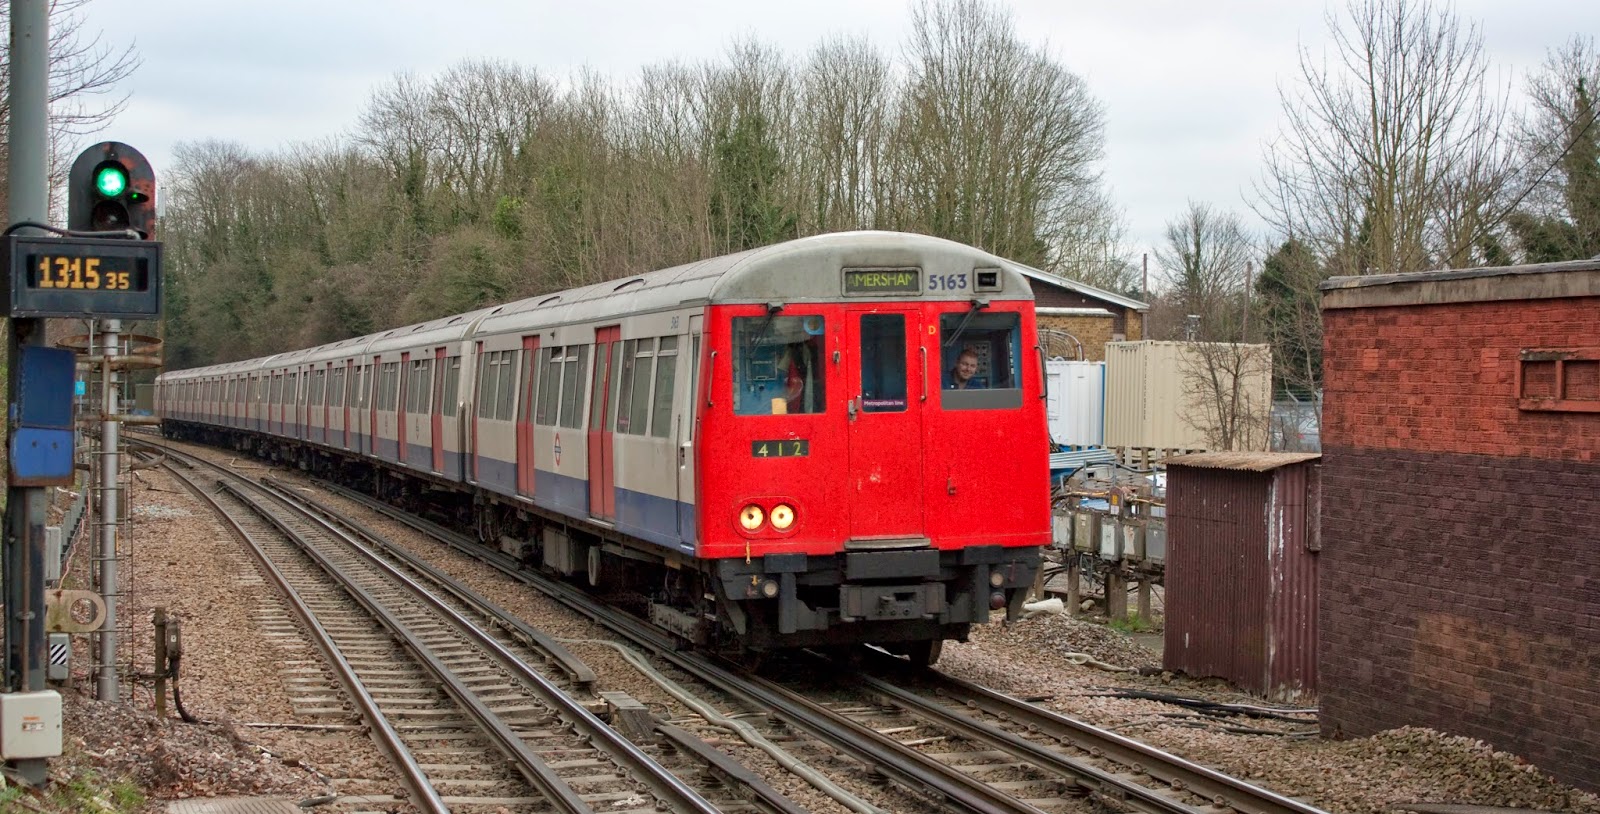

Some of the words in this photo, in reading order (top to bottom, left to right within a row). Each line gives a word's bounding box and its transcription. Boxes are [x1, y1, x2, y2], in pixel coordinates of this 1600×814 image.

[105, 272, 130, 290] 35
[928, 273, 967, 290] 5163
[928, 325, 937, 335] D
